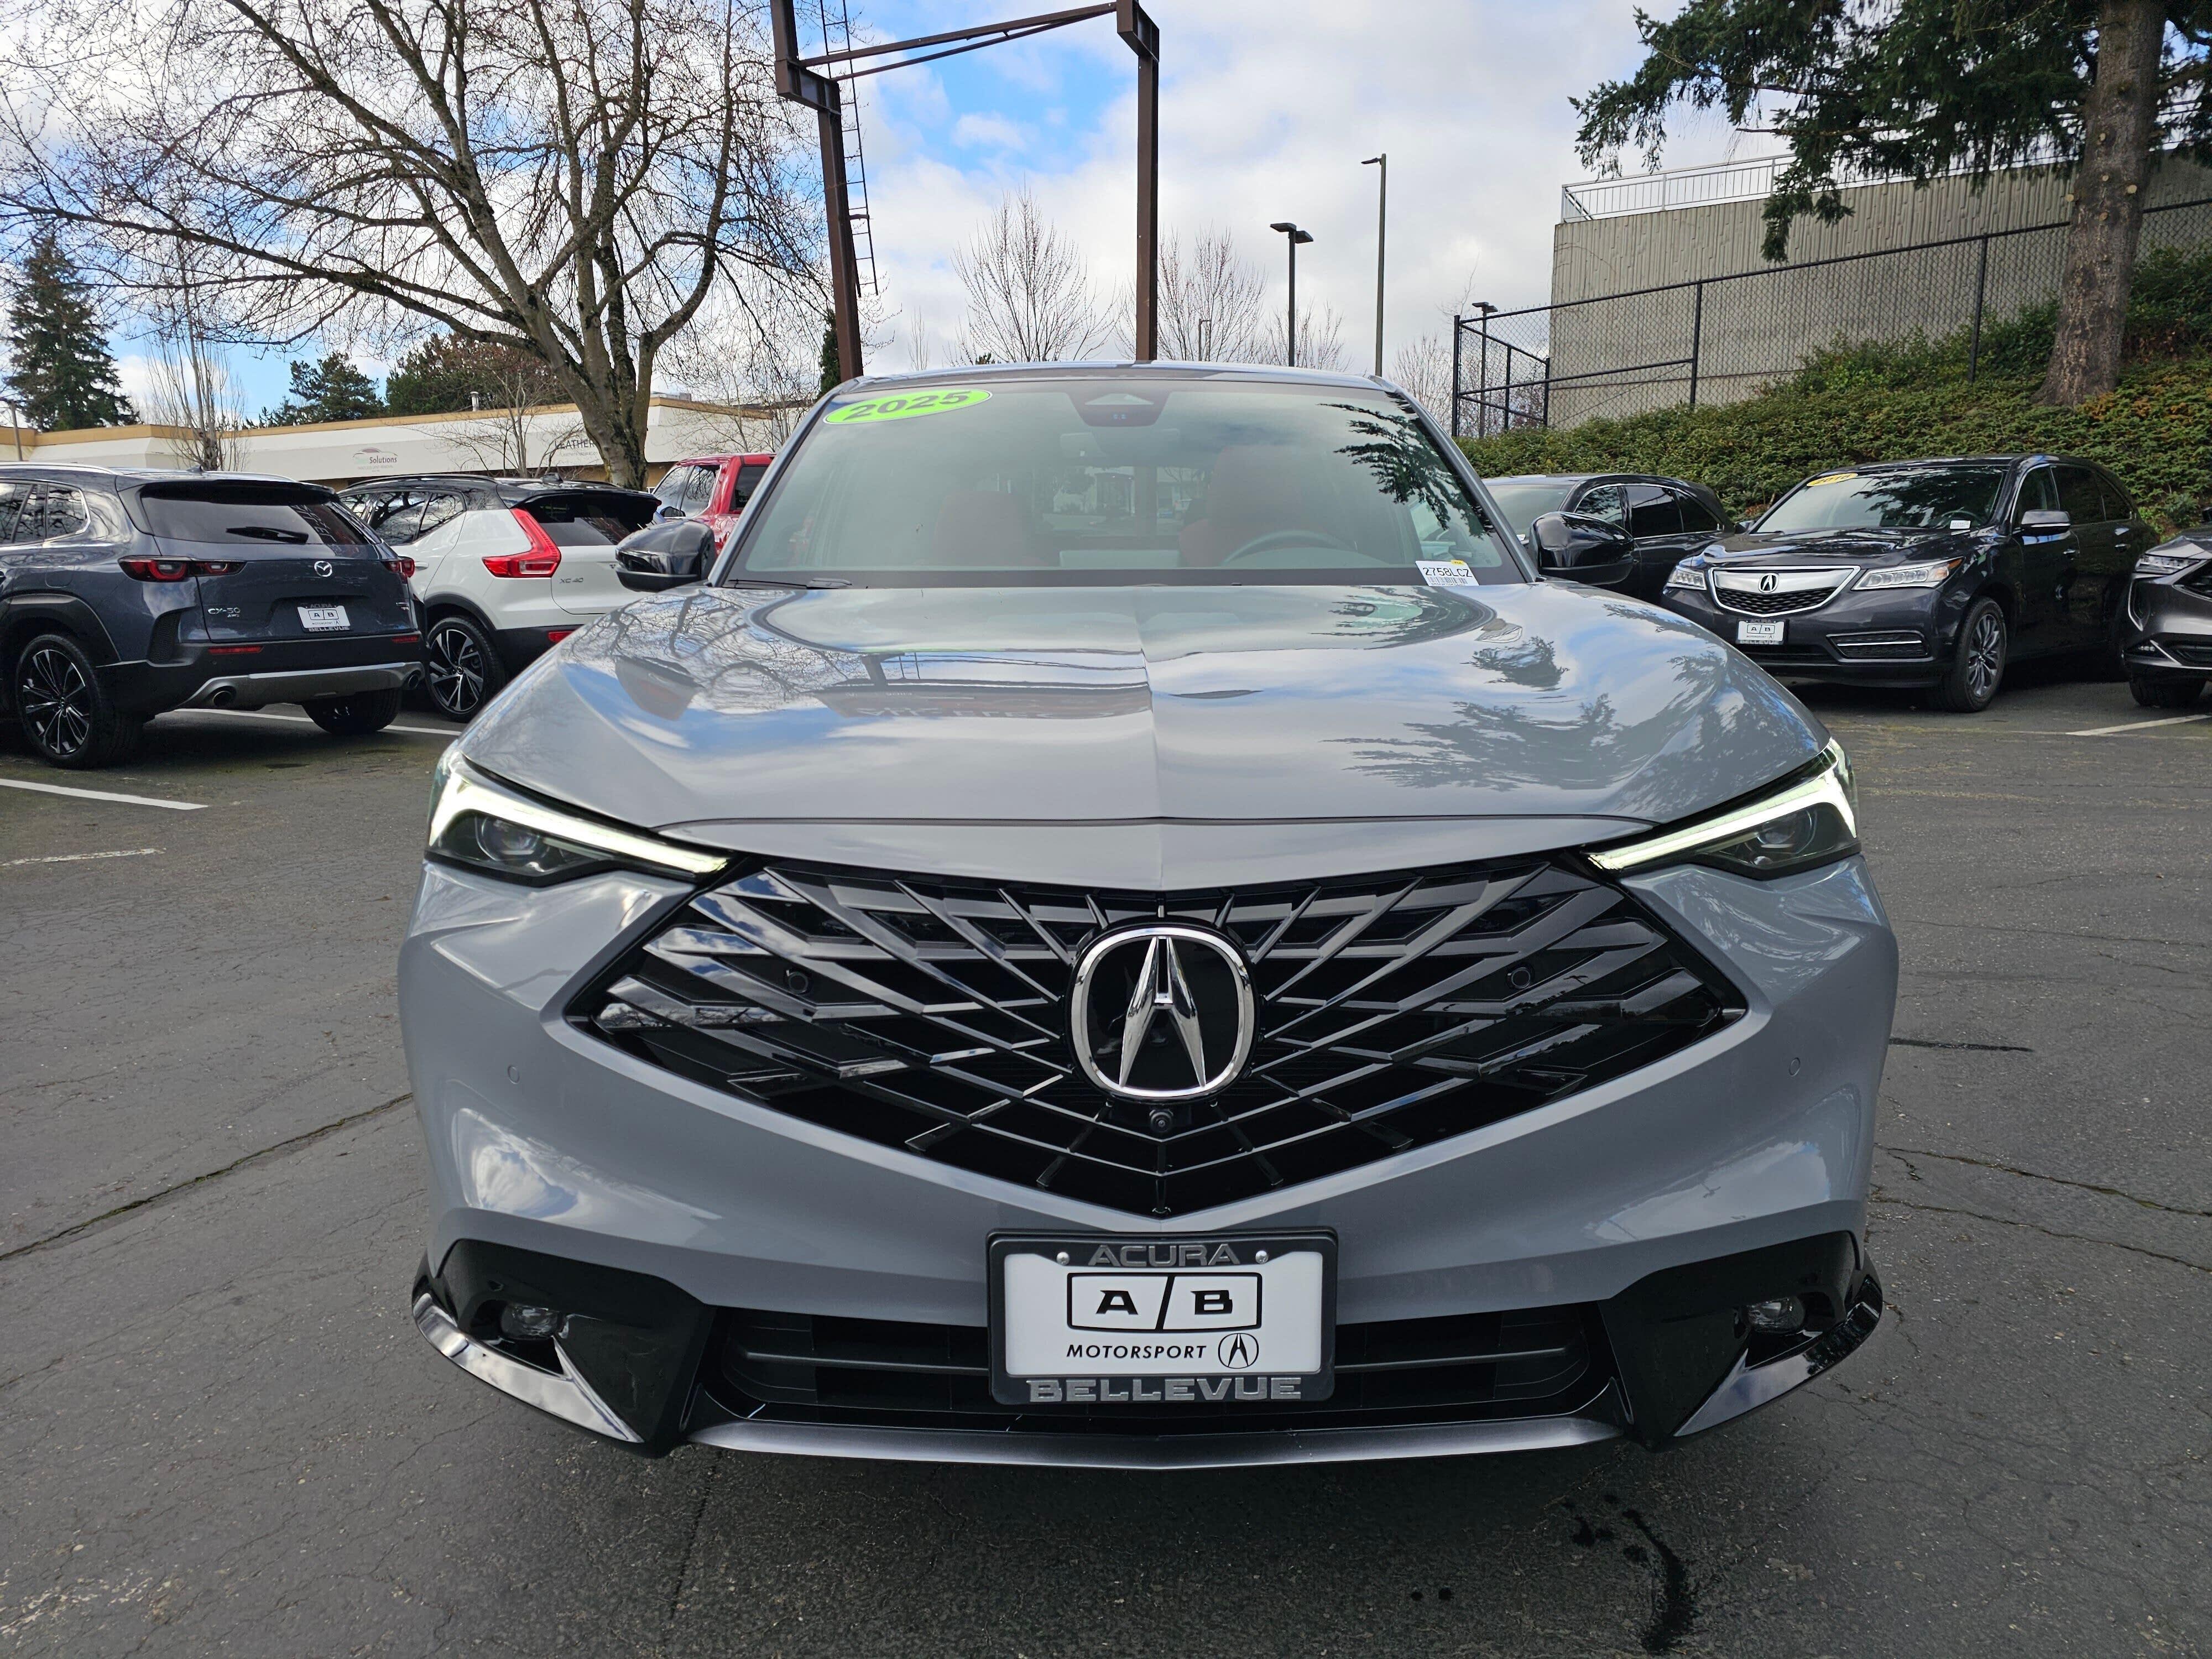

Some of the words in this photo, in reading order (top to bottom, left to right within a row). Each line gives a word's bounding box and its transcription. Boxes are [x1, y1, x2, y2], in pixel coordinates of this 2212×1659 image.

[843, 390, 971, 421] 2025
[555, 439, 595, 450] LEATHER
[369, 455, 398, 463] Solutions
[1423, 567, 1473, 577] 2758LCZ
[1088, 1243, 1241, 1267] ACURA
[1066, 1344, 1207, 1359] MOTORSPORT
[1026, 1377, 1301, 1402] BELLEVUE
